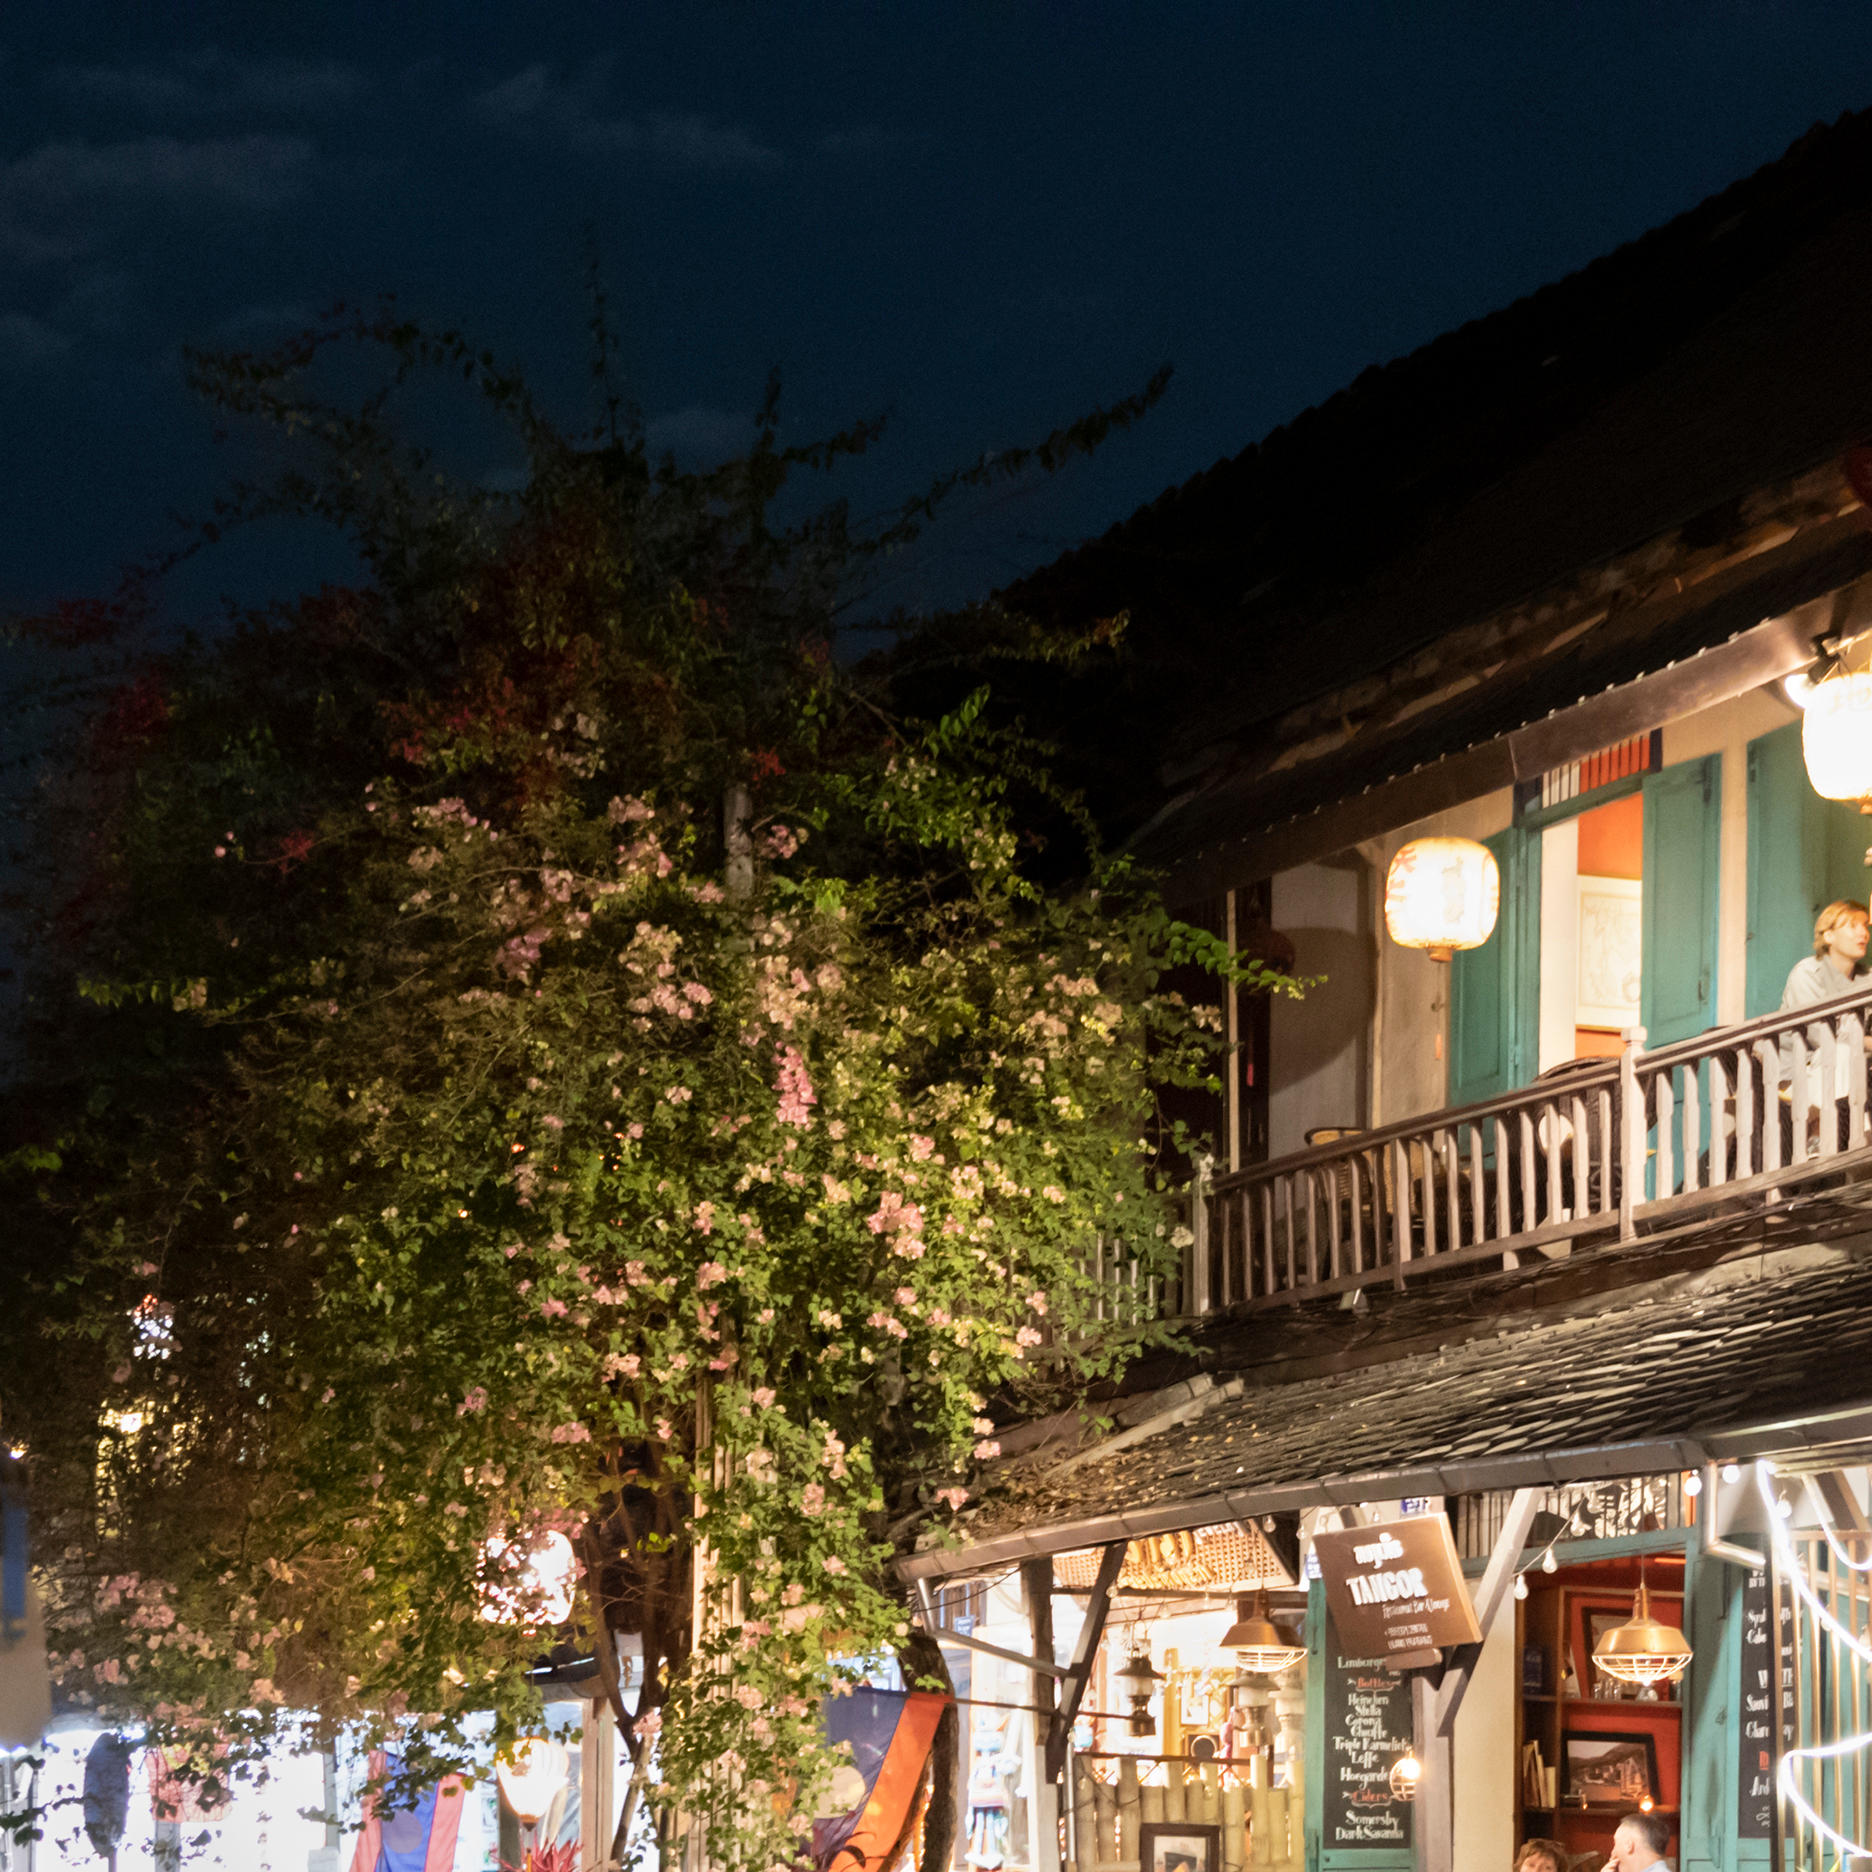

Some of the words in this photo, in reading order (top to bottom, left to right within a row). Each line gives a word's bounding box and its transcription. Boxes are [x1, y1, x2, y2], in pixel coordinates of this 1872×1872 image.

[1348, 1693, 1389, 1706] Heineken
[1352, 1751, 1378, 1768] Leffe
[1352, 1789, 1388, 1802] Ciders
[1345, 1810, 1399, 1832] Somersby
[1336, 1825, 1362, 1840] Dark
